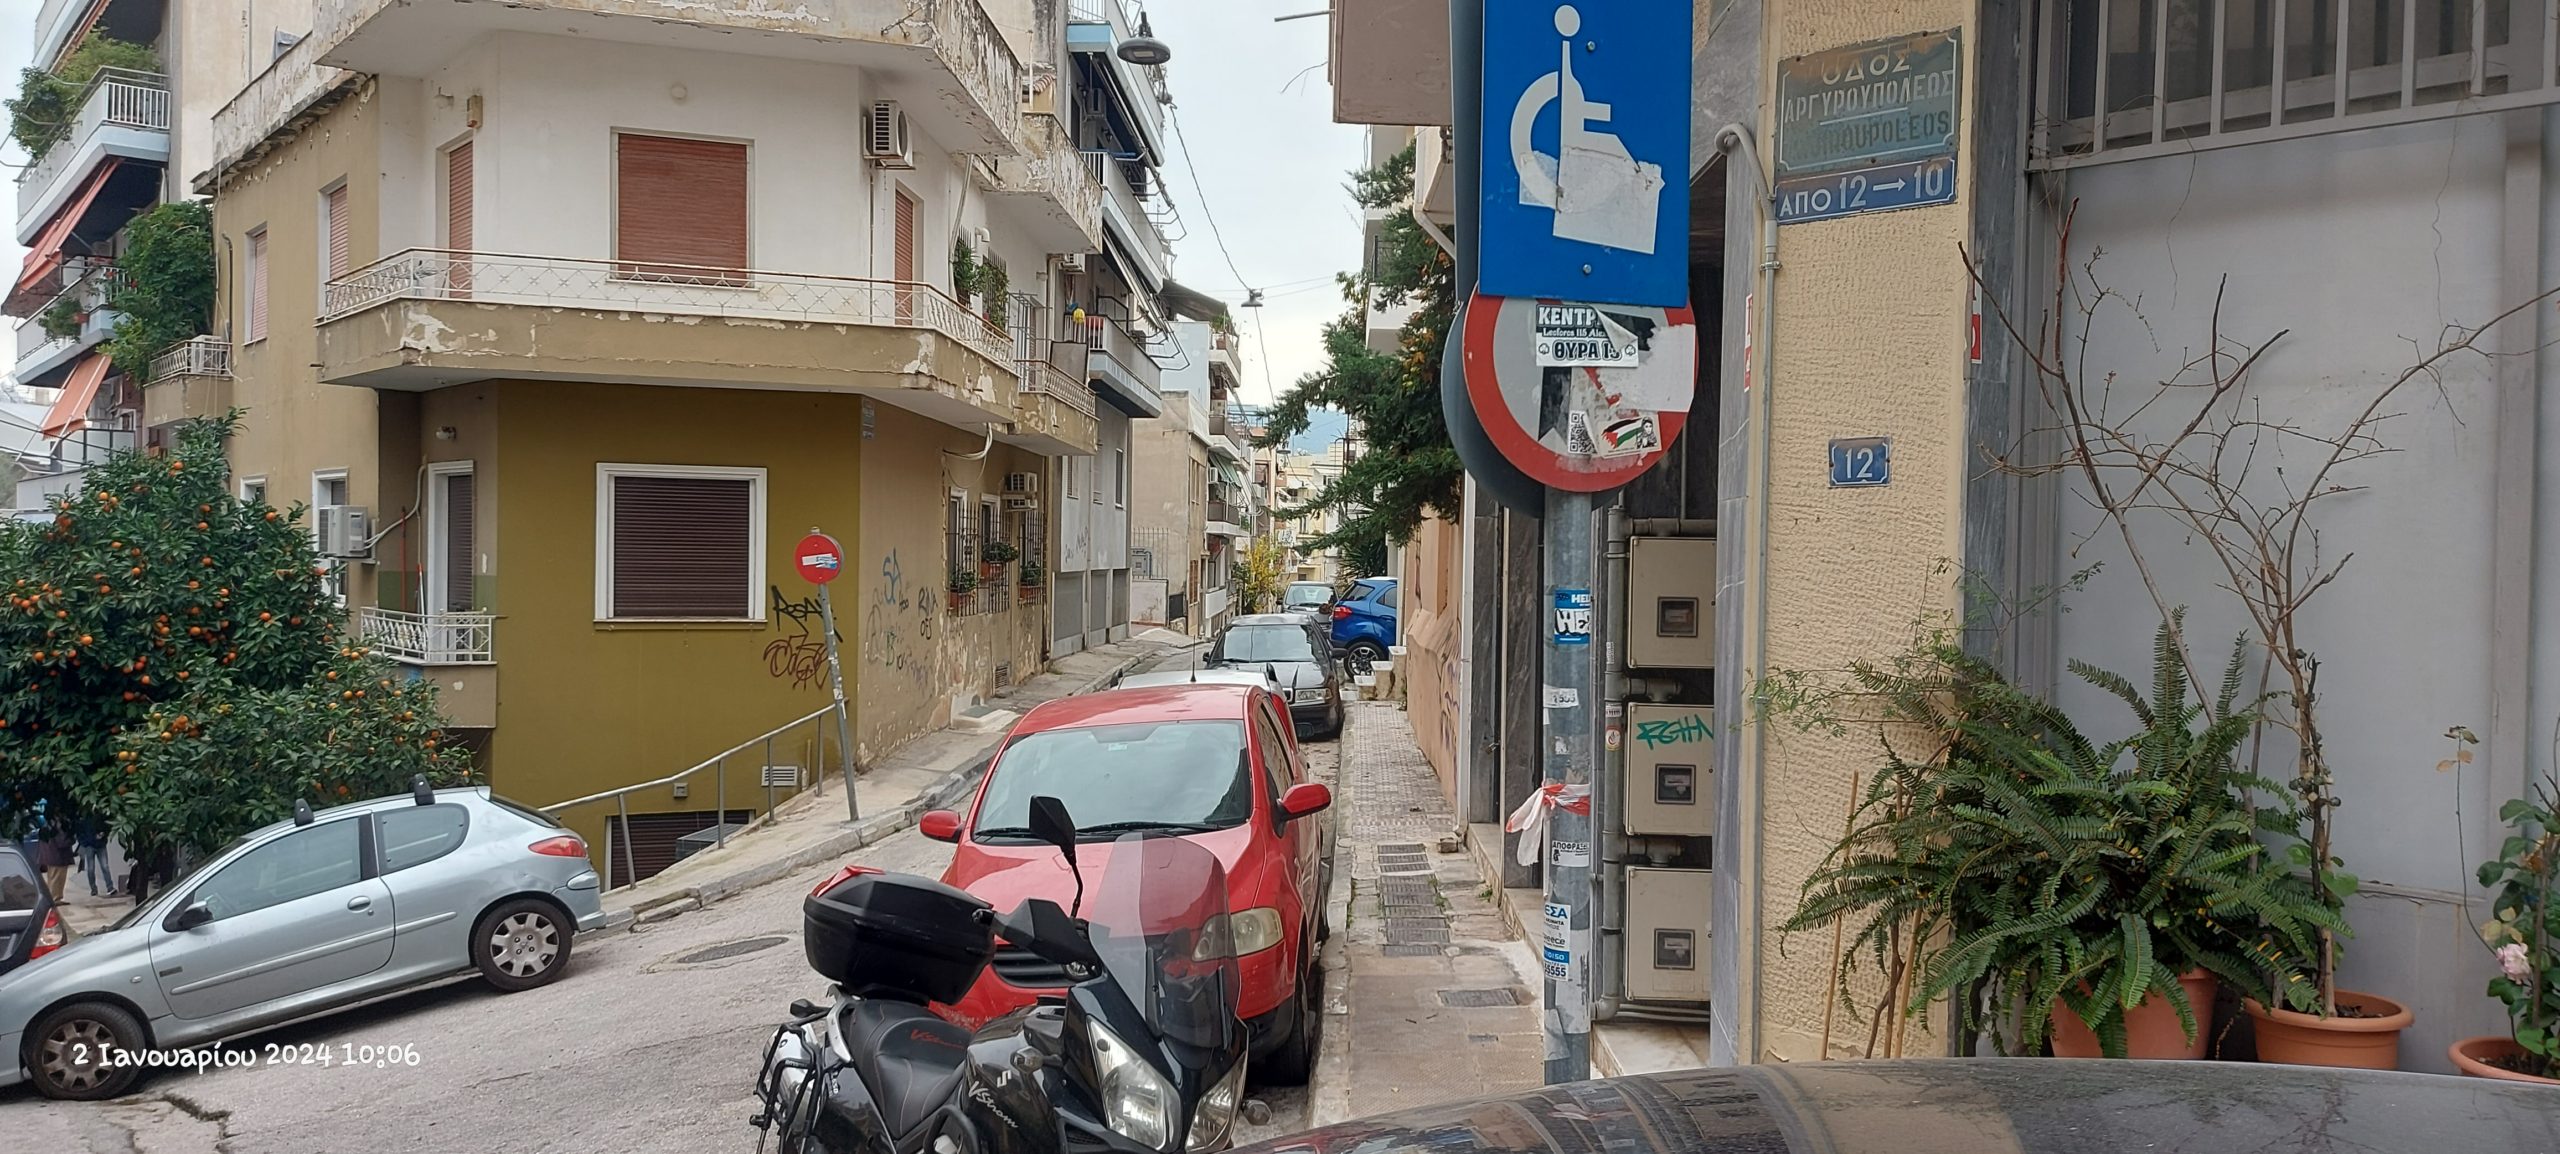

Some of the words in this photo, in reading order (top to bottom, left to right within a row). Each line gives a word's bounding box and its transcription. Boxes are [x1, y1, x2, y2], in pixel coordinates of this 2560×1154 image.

[1784, 69, 1953, 124] ΑΡΓΥΡΟΥΠΟΛΕΩΣ
[1779, 188, 1832, 217] ΑΠΟ
[1839, 175, 1868, 209] 12
[1913, 163, 1944, 199] 10
[1554, 342, 1599, 359] ΘΥΡΑ
[1846, 447, 1874, 479] 12
